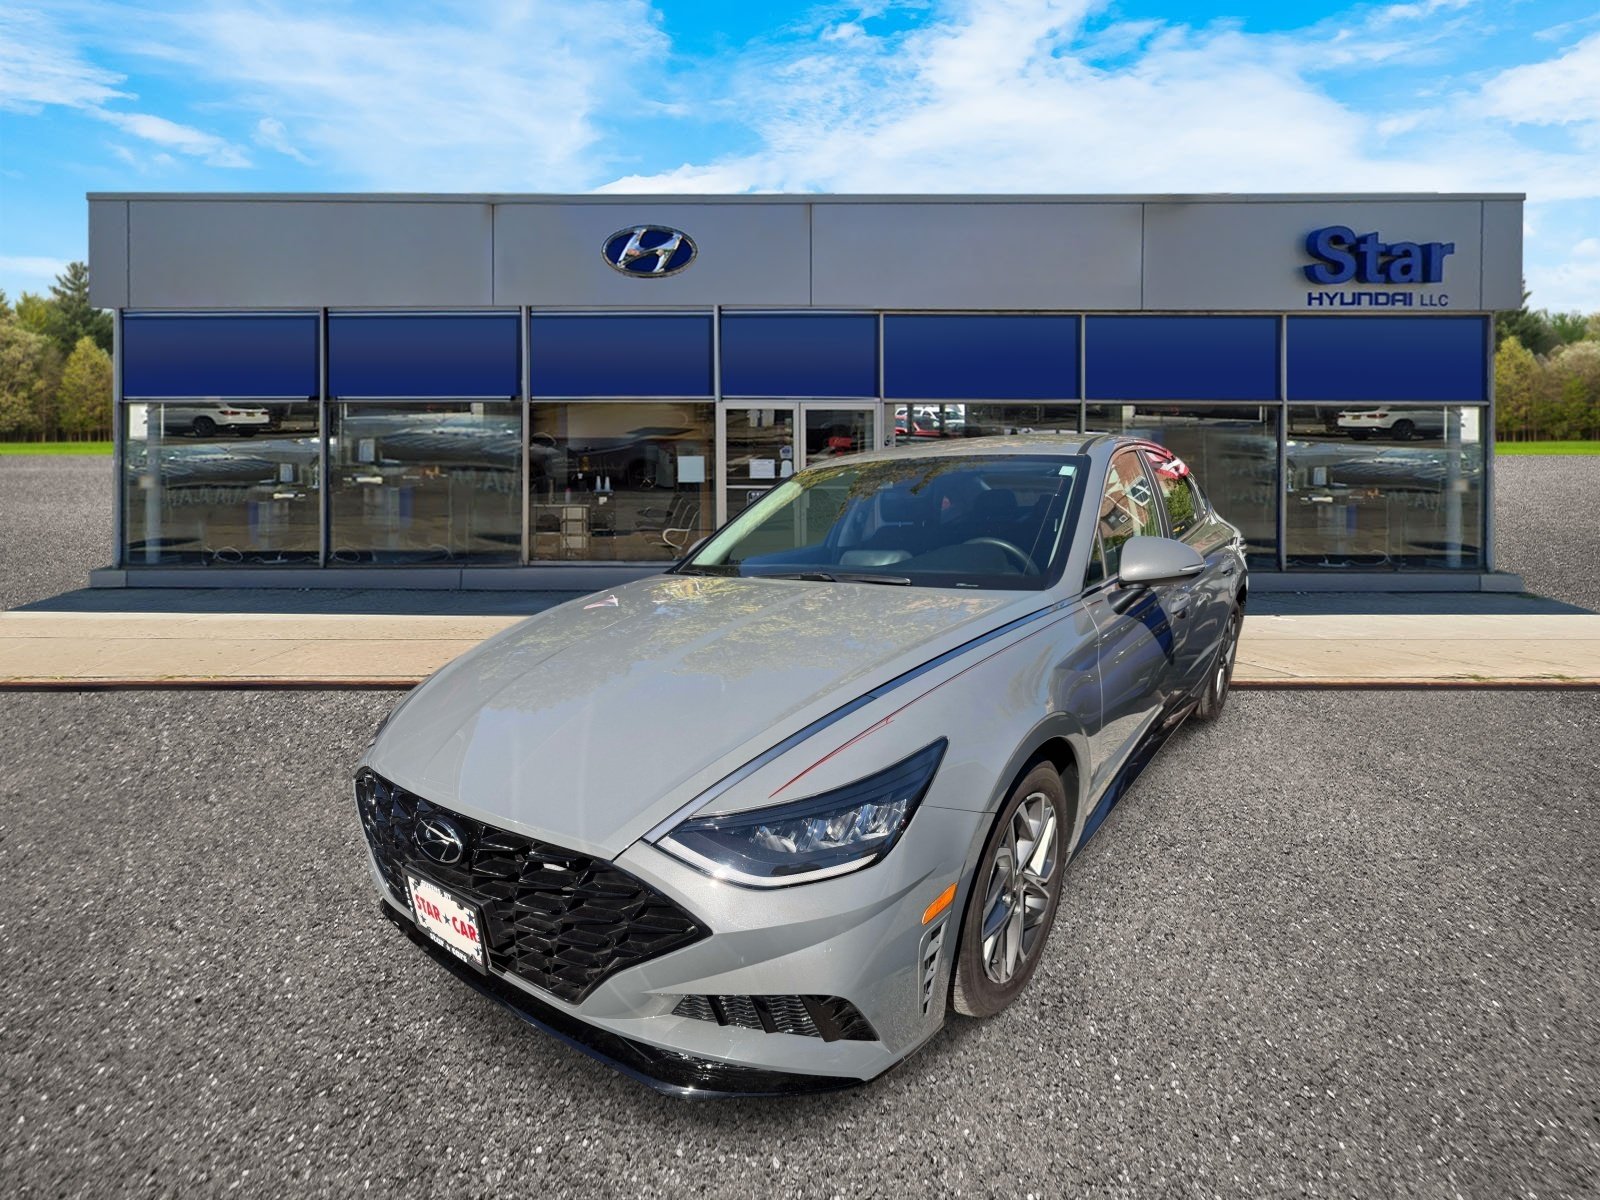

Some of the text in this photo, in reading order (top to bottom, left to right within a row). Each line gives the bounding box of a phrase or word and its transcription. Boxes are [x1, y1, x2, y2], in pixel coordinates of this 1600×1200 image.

[1303, 225, 1455, 285] Star
[1307, 292, 1449, 307] HYUNDAI LLC
[415, 893, 442, 923] STAR
